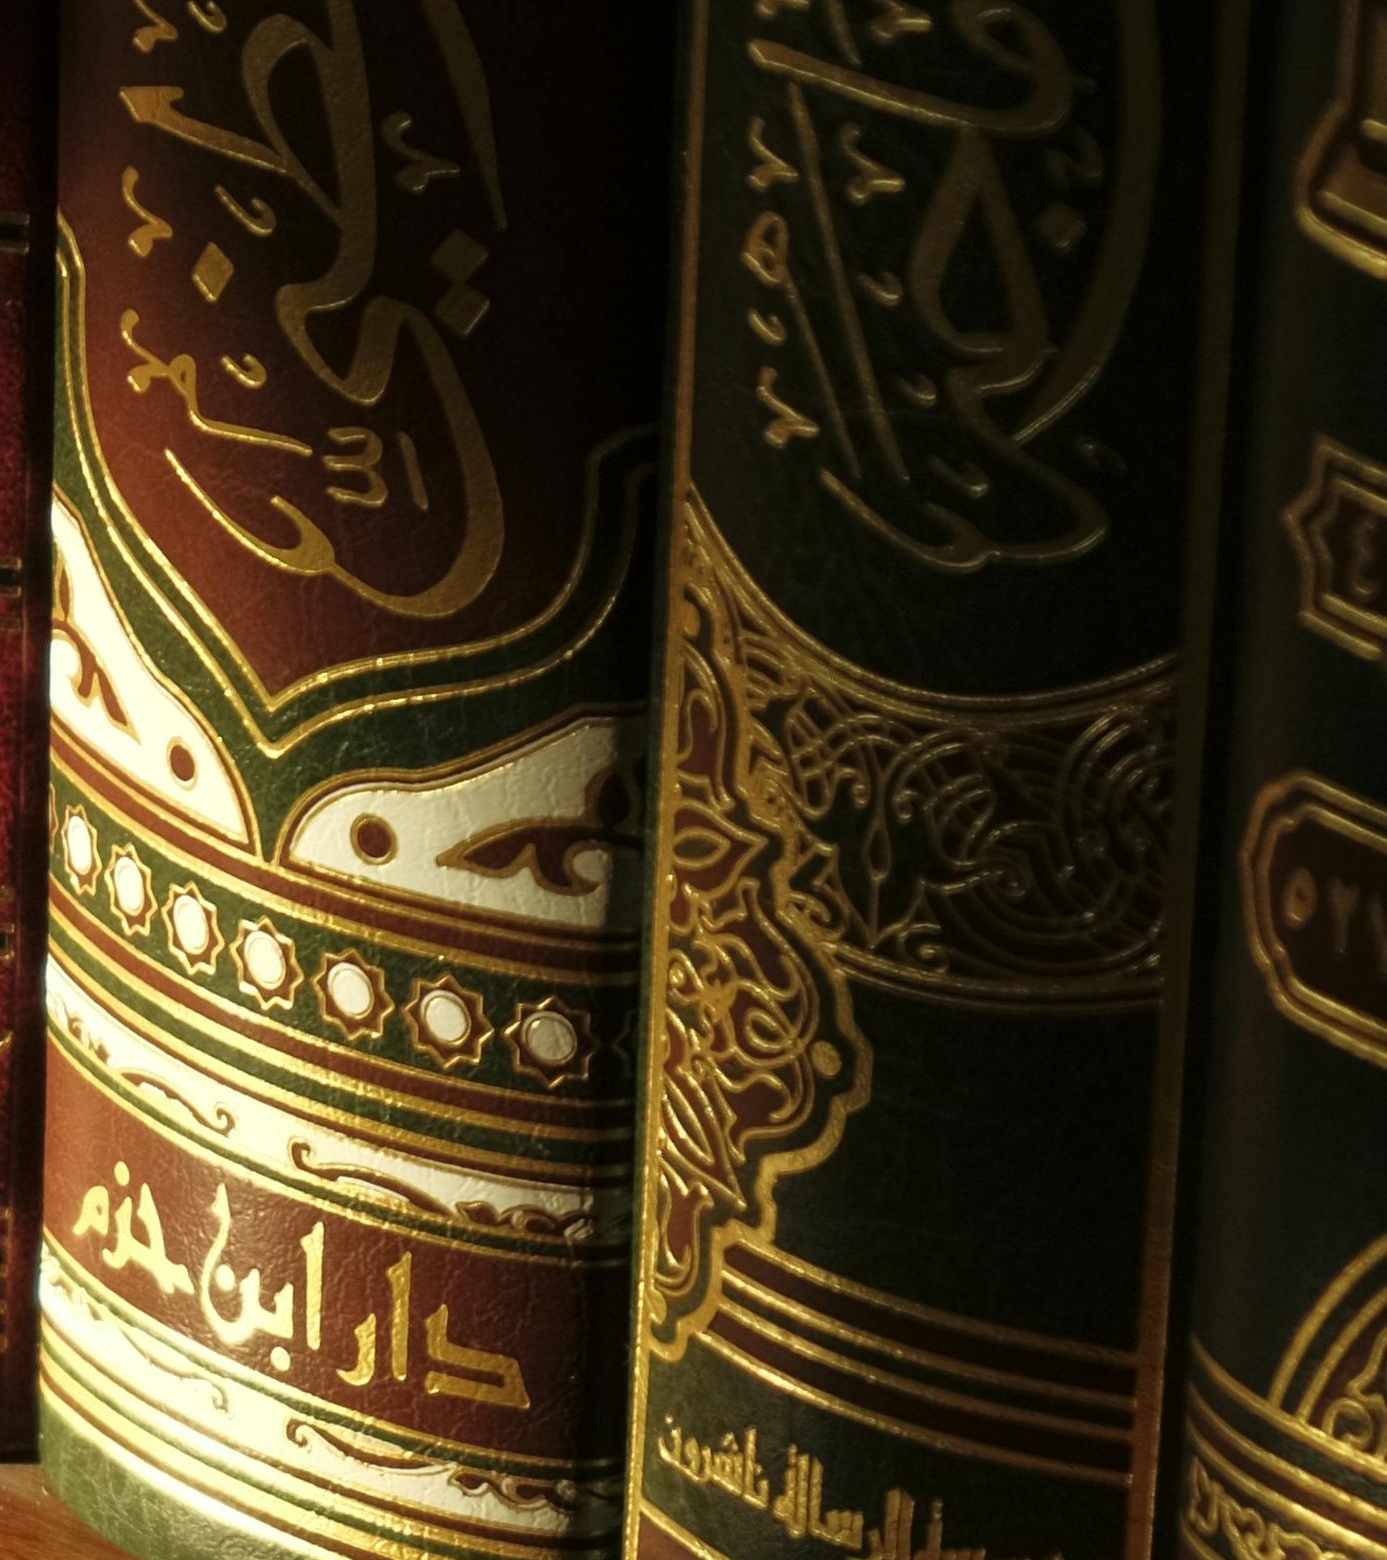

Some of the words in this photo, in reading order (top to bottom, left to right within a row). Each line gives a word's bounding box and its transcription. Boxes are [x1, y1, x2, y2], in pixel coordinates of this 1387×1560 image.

[72, 1160, 196, 1297] حزم
[199, 1182, 327, 1373] ابن
[335, 1248, 532, 1410] دار
[657, 1413, 770, 1510] ناشرون
